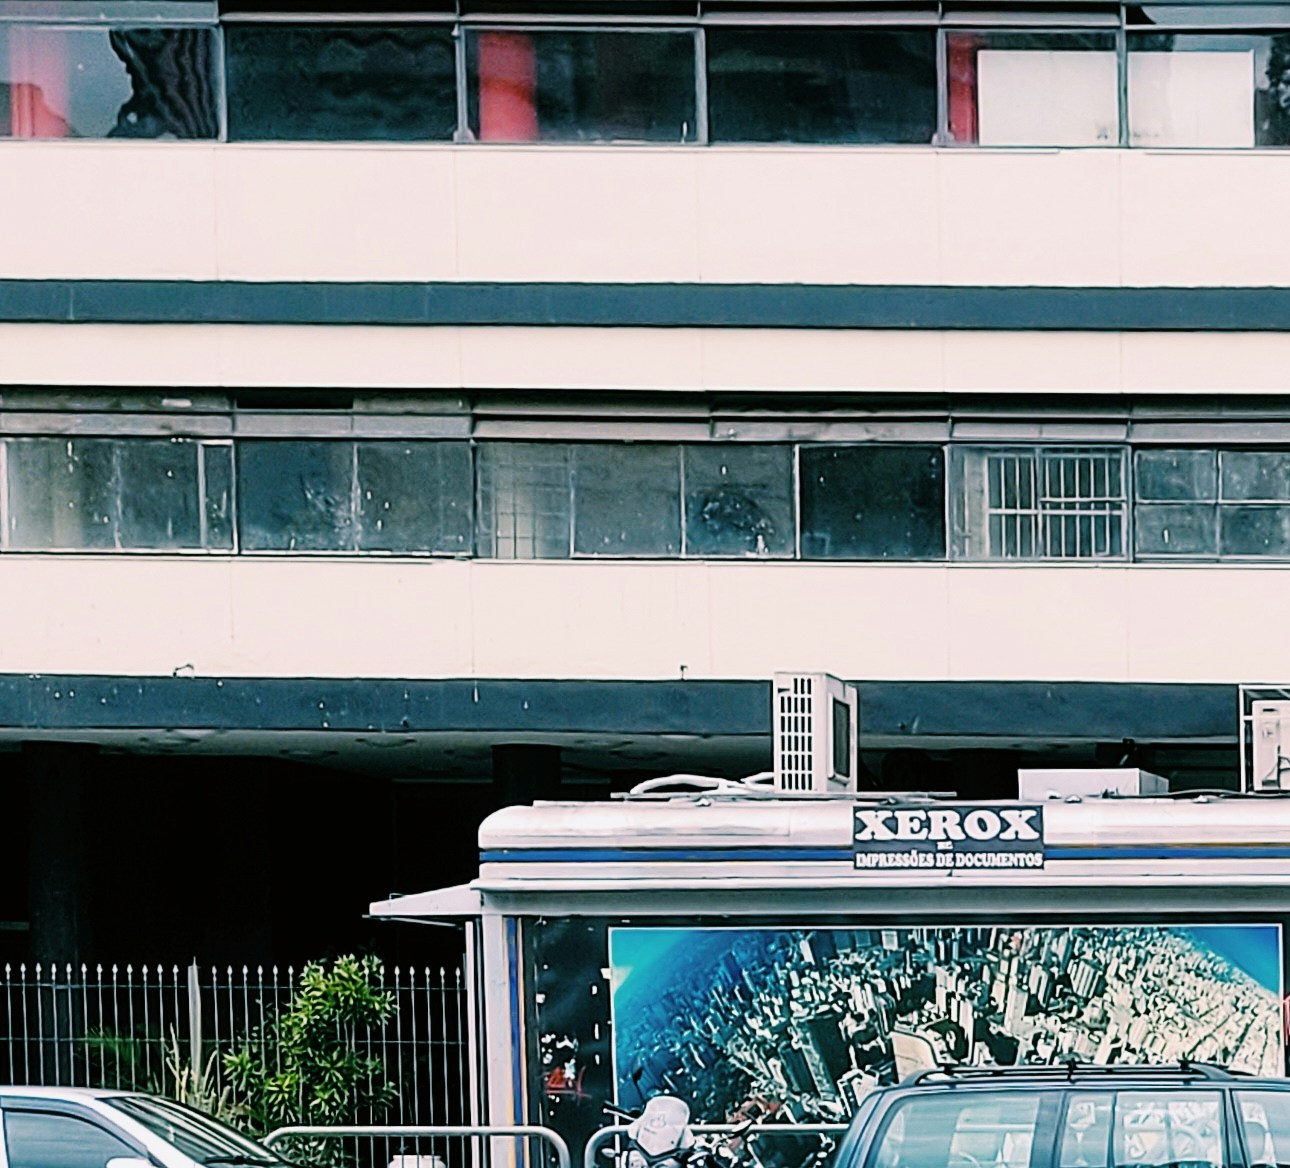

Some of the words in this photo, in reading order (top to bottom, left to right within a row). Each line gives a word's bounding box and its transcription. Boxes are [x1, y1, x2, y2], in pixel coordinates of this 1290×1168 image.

[855, 809, 1040, 841] XEROX
[856, 849, 934, 868] IMPRESSÕES
[936, 852, 954, 868] DE
[955, 852, 1043, 868] DOCUMENTOS
